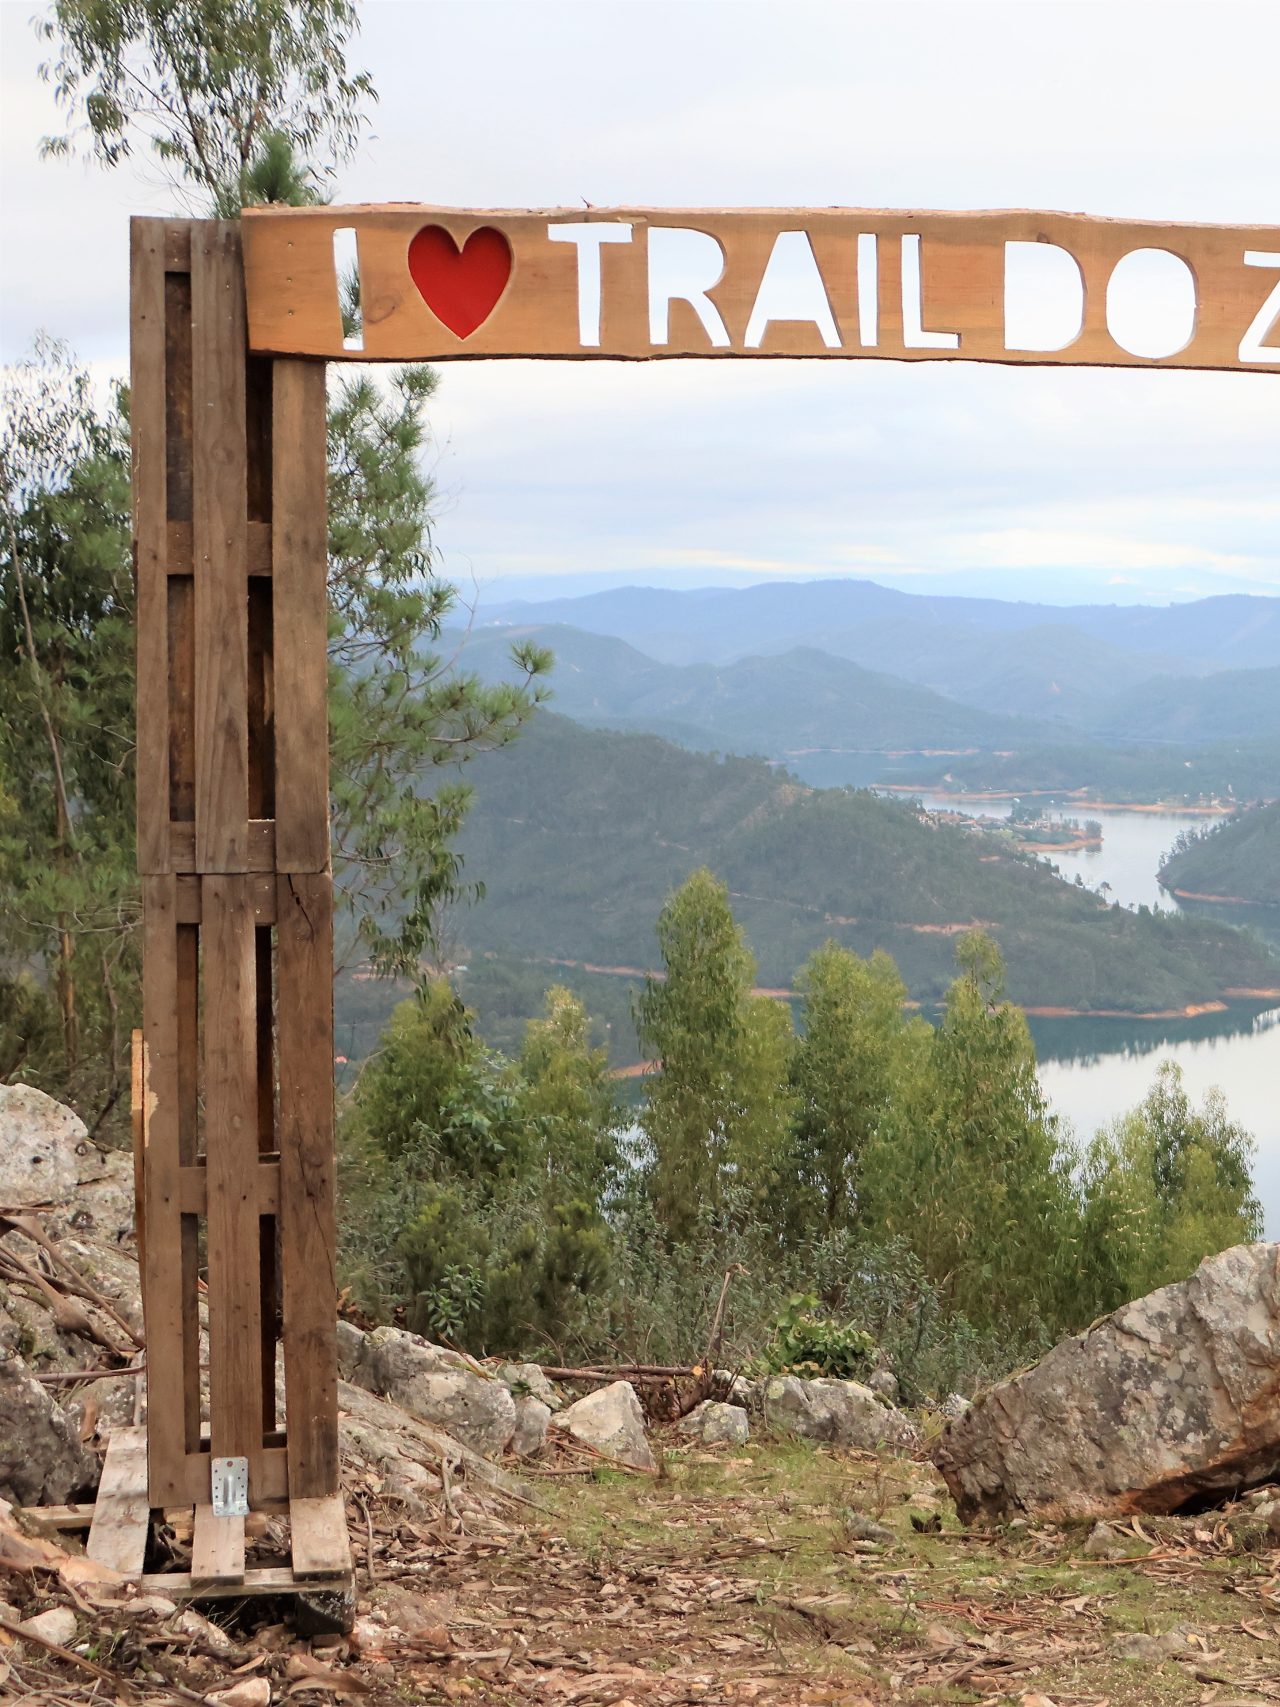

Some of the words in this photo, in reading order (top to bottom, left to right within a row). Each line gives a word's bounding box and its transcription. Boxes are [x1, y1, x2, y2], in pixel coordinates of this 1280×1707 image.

[333, 227, 364, 351] I
[547, 222, 962, 349] TRAIL
[1003, 240, 1199, 360] DO
